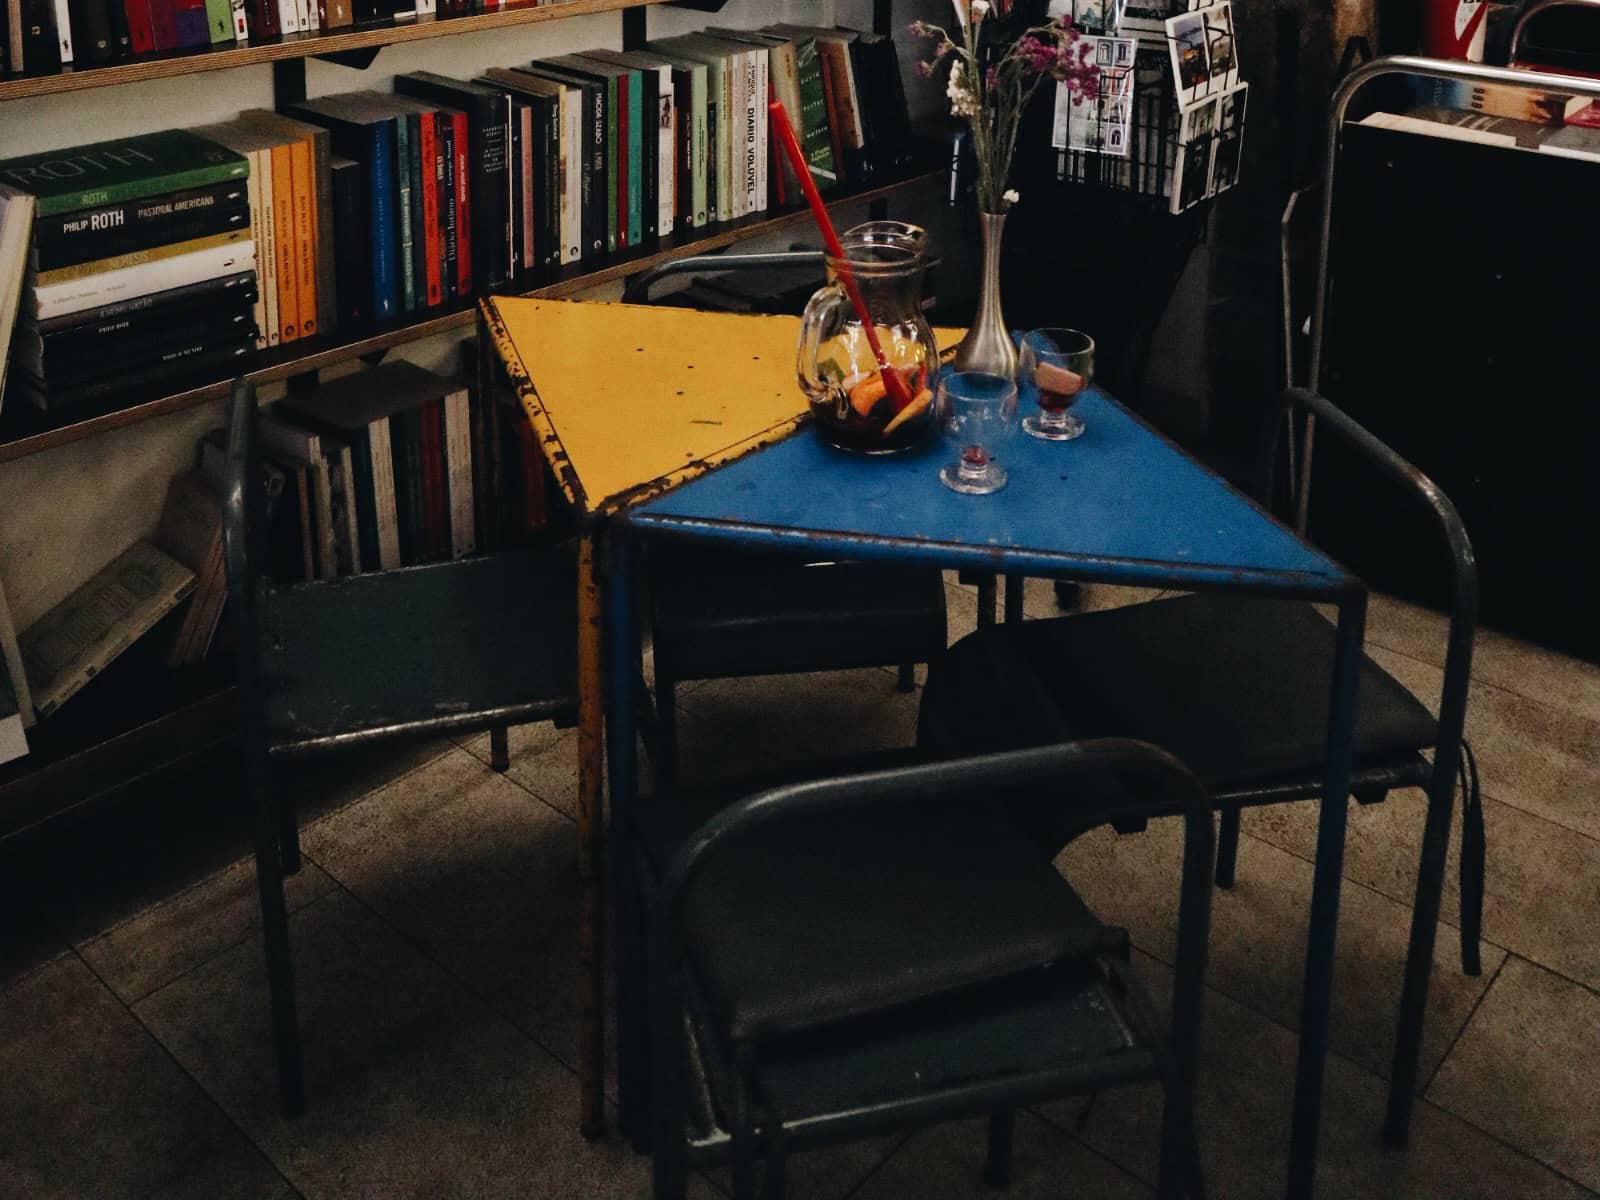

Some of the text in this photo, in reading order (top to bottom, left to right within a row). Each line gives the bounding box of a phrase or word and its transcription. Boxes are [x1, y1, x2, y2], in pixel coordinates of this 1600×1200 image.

[5, 147, 154, 185] ROTH
[63, 196, 215, 234] PHILIP ROTH PASTORAL AMERICANA
[81, 191, 108, 204] ROTH
